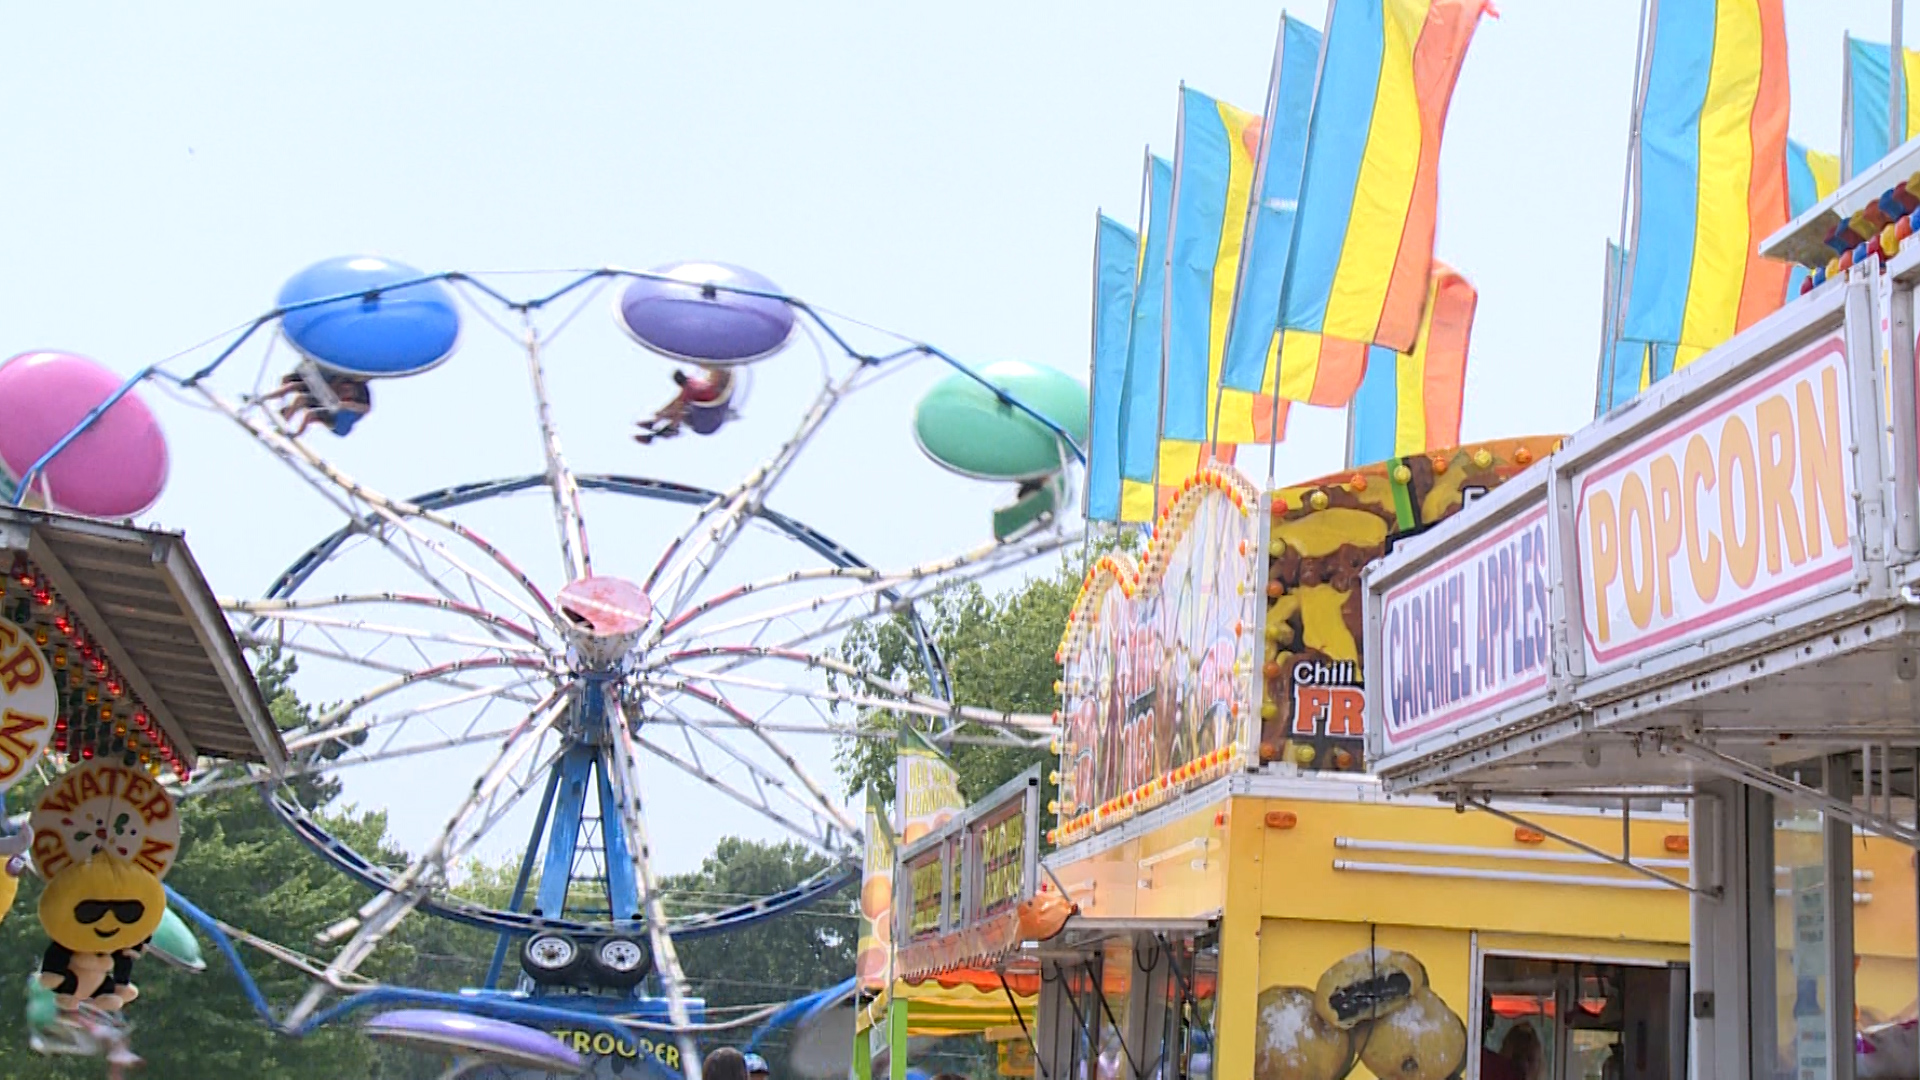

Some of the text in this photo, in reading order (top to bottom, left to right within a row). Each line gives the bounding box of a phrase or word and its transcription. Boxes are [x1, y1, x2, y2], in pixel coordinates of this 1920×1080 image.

[1588, 365, 1849, 644] POPCORN
[1294, 661, 1353, 684] Chili
[1390, 571, 1471, 728] CARAMEL
[1476, 523, 1547, 693] APPLES
[39, 766, 171, 823] WATER
